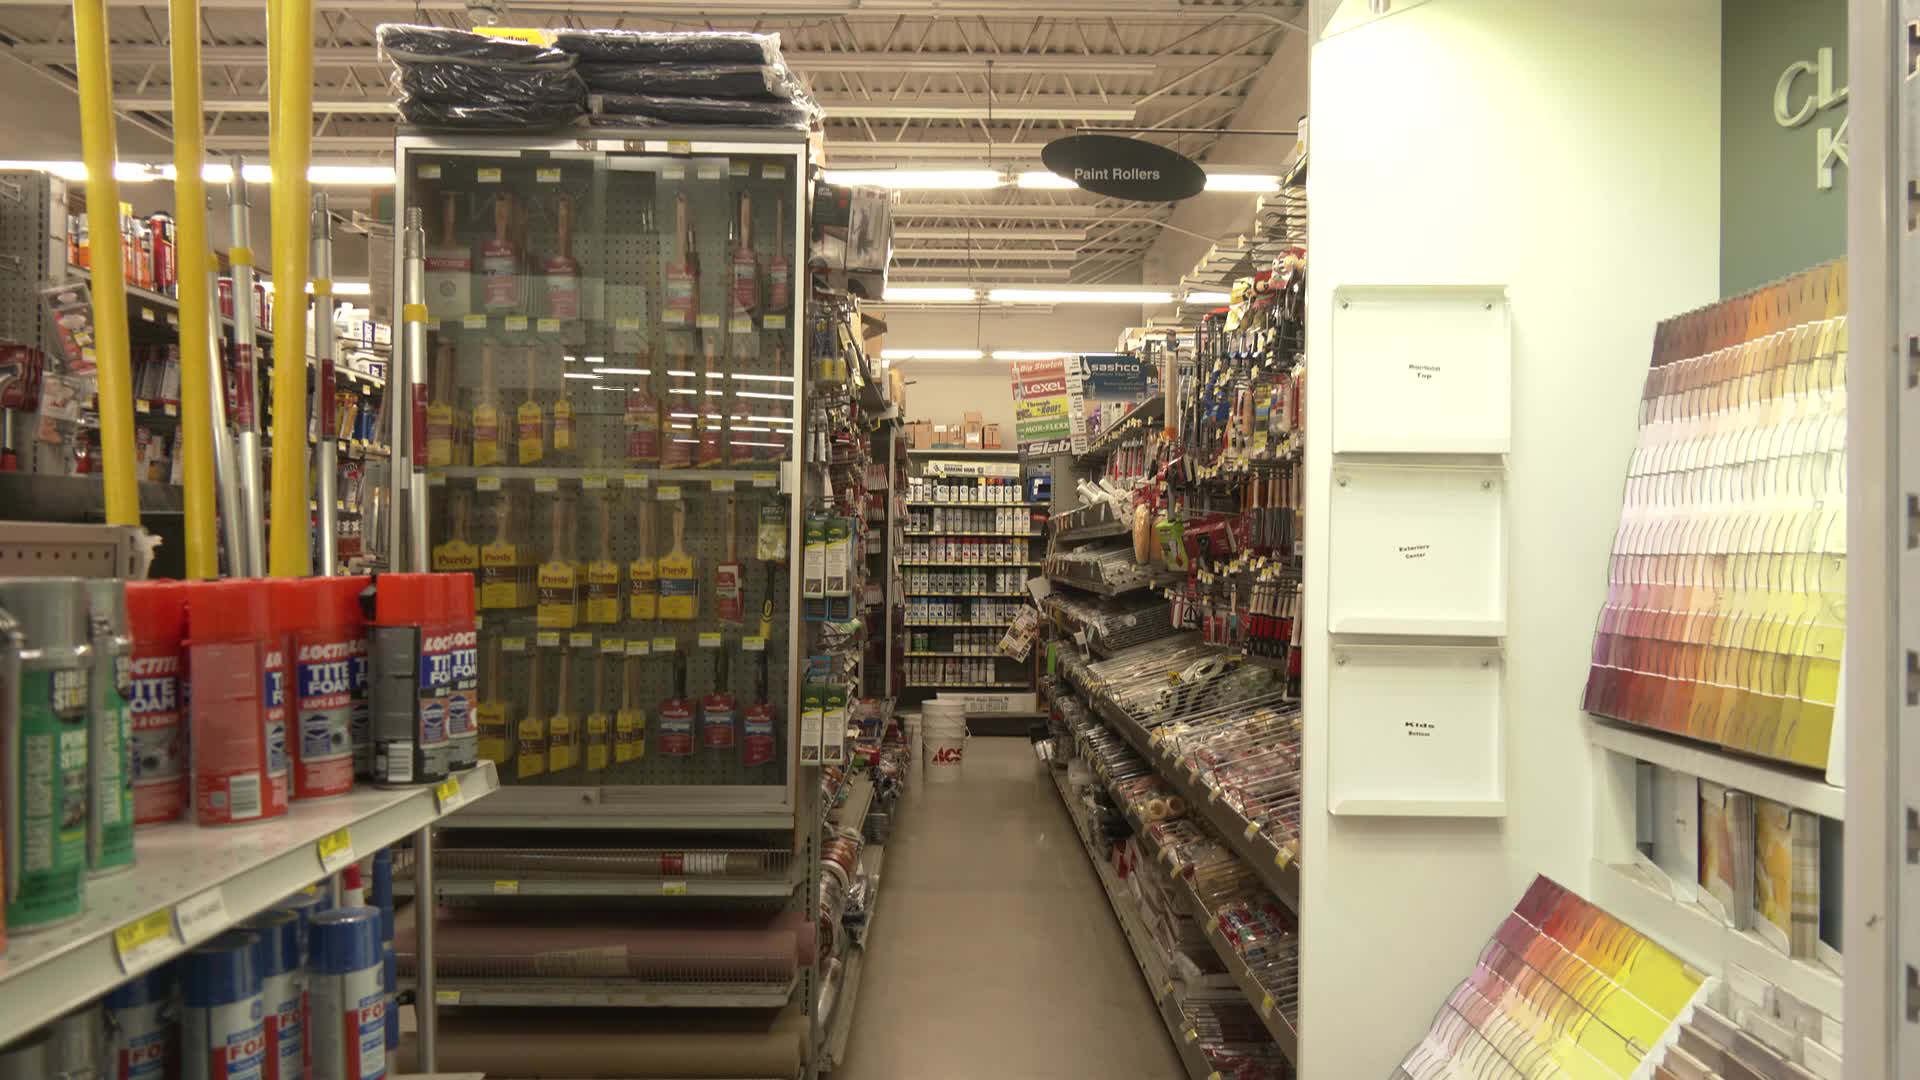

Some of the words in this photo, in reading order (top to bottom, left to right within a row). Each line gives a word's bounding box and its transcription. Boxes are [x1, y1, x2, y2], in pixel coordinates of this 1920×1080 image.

[1074, 167, 1109, 181] Paint
[1112, 168, 1161, 181] Rollers
[1091, 362, 1140, 372] sashco
[1027, 440, 1071, 456] Slab
